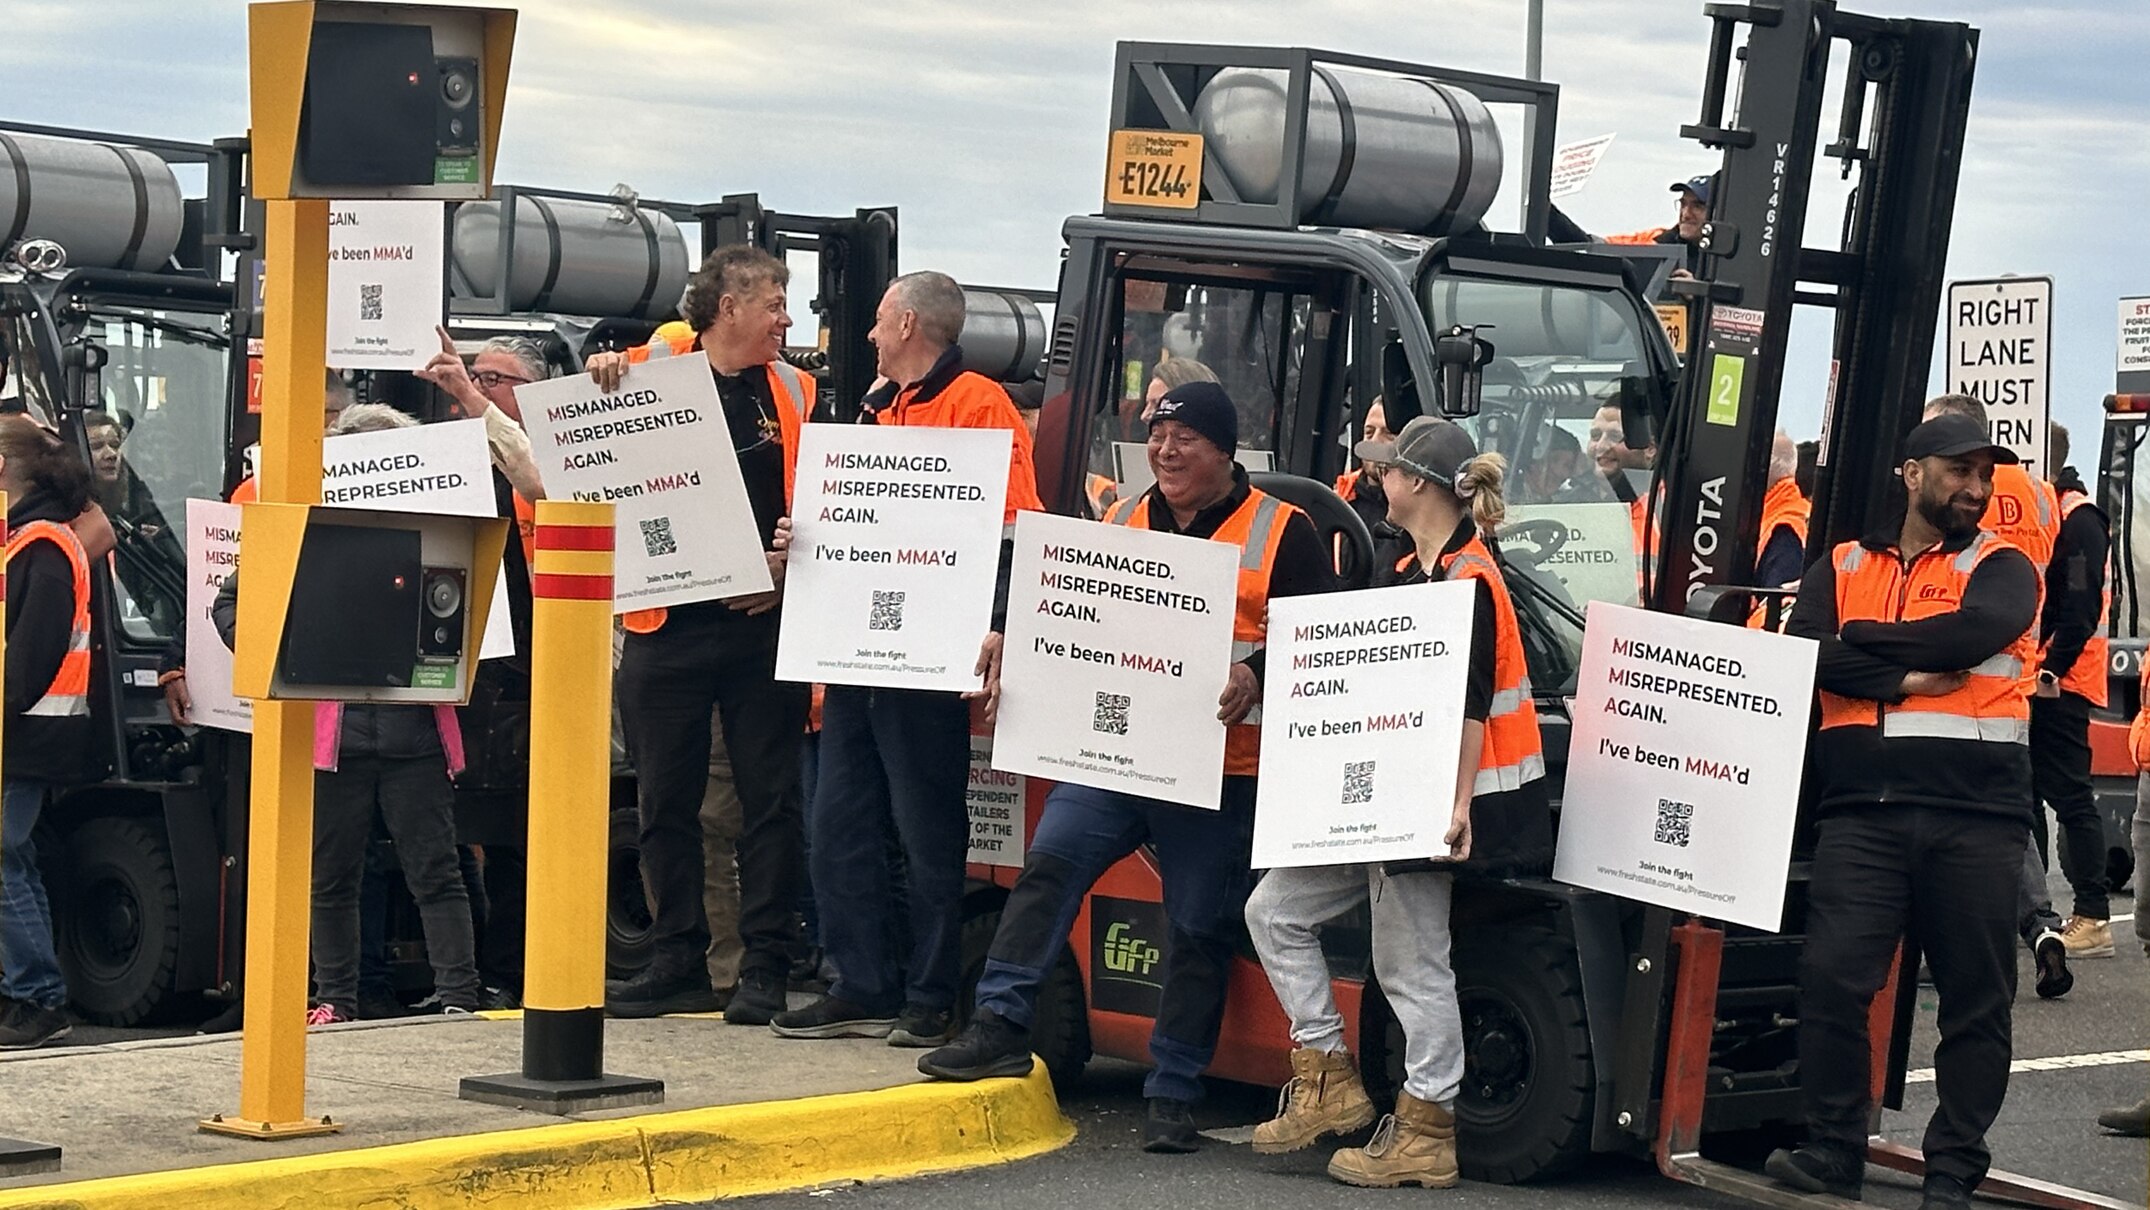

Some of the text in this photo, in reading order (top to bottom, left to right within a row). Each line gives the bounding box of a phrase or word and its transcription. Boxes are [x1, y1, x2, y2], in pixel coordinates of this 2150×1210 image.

[1144, 147, 1174, 157] Market
[1145, 137, 1189, 148] Melbourne
[1122, 161, 1187, 198] E1244
[1761, 143, 1788, 256] VR14626
[329, 213, 359, 226] GAIN.
[342, 246, 370, 260] been
[373, 246, 413, 261] MMA'd
[1728, 310, 1763, 323] TOYOTA
[1959, 298, 2039, 327] RIGHT
[2135, 304, 2150, 315] ST
[1960, 339, 2035, 366] LANE
[1717, 374, 1733, 406] 2
[1960, 379, 2035, 405] MUST
[547, 389, 662, 423] MISMANAGED.
[554, 408, 703, 447] MISREPRESENTED.
[1989, 418, 2033, 445] RN
[322, 454, 425, 479] MANAGED.
[563, 449, 618, 472] AGAIN.
[825, 453, 952, 473] MISMANAGED.
[324, 473, 467, 504] REPRESENTED.
[573, 470, 701, 502] I've been MMA'd
[822, 479, 986, 502] MISREPRESENTED.
[819, 506, 879, 524] AGAIN.
[205, 550, 240, 567] MISRE
[815, 545, 957, 567] I've been MMA'd
[1043, 544, 1175, 580] MISMANAGED.
[1040, 571, 1211, 614] MISREPRESENTED.
[1037, 599, 1101, 623] AGAIN.
[1295, 616, 1416, 642] MISMANAGED.
[1034, 637, 1183, 678] I've been MMA'd
[1293, 641, 1449, 670] MISREPRESENTED.
[1612, 637, 1747, 679] MISMANAGED.
[1290, 679, 1349, 698] AGAIN.
[1608, 667, 1782, 717] MISREPRESENTED.
[1604, 697, 1667, 724] AGAIN.
[1288, 711, 1423, 739] I've been MMA'd
[1599, 738, 1750, 786] I've been MMA'd
[970, 768, 1017, 787] RCING
[969, 805, 1009, 820] TAILERS
[975, 822, 990, 834] OF
[992, 823, 1012, 836] THE
[968, 838, 1003, 851] ARKET
[1638, 860, 1694, 881] Join the fight
